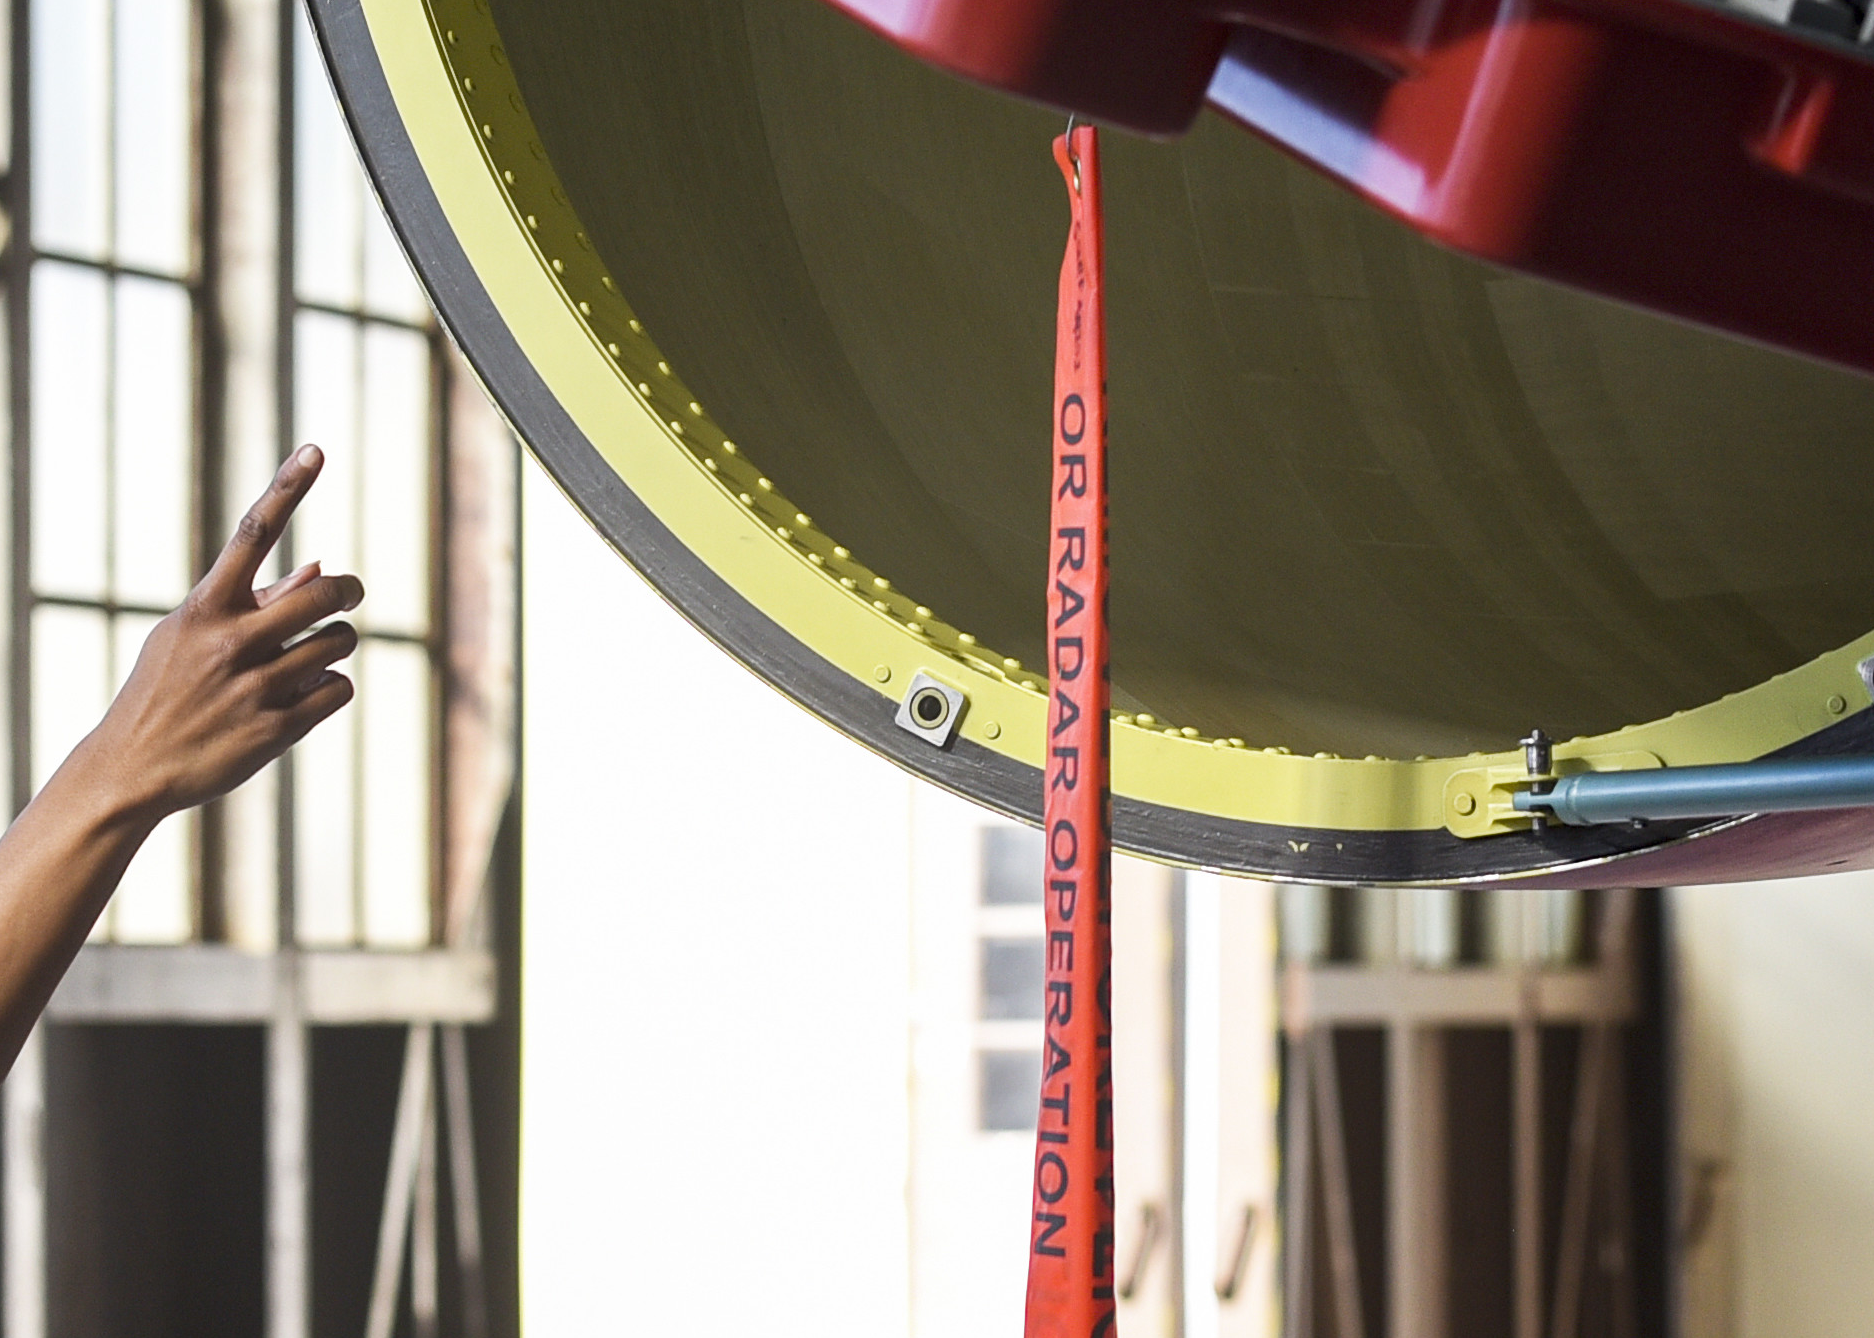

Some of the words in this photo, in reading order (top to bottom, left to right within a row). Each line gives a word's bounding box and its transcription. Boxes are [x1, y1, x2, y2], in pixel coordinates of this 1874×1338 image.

[1056, 393, 1087, 503] OR
[1050, 525, 1085, 793] RADAR
[1033, 819, 1077, 1258] OPERATION
